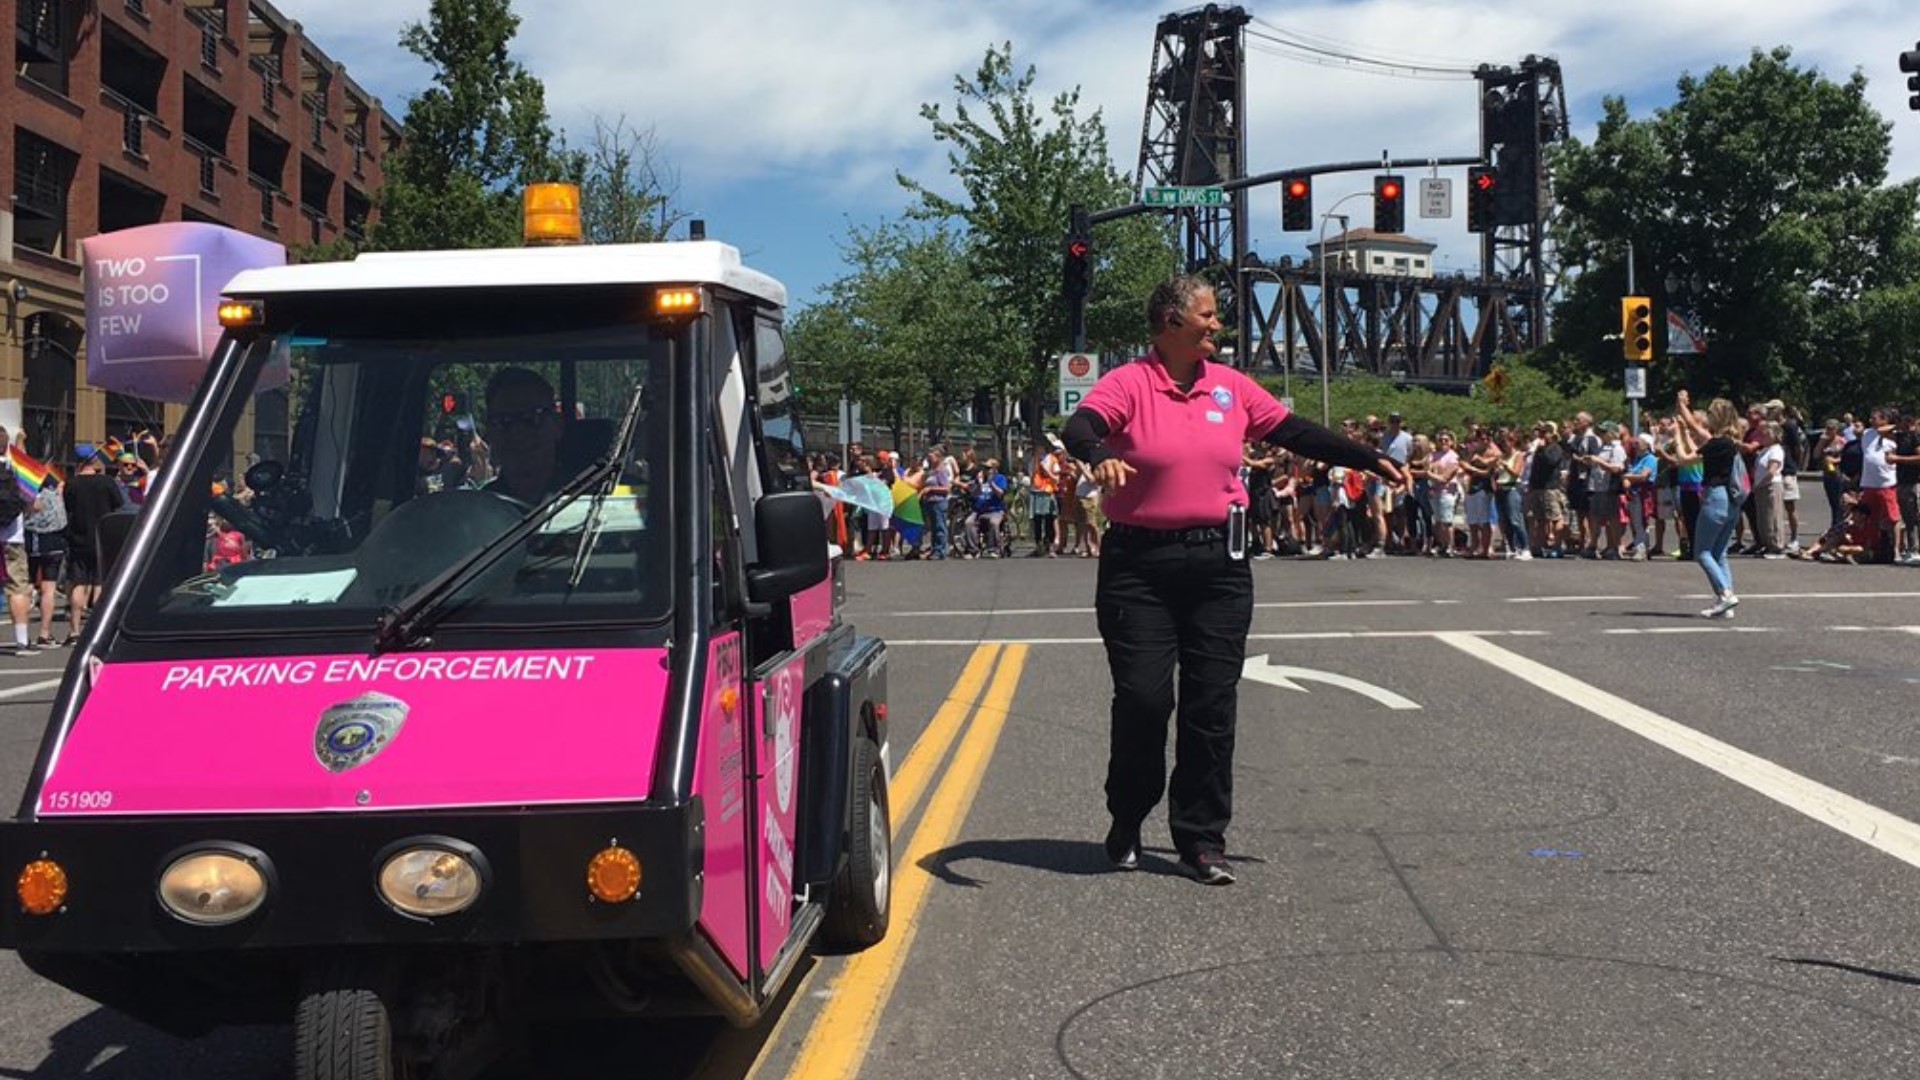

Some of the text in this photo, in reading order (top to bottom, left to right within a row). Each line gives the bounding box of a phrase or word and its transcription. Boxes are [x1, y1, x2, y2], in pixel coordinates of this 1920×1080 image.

[1163, 189, 1219, 203] NW DAVIS ST
[95, 257, 146, 278] TWO
[99, 283, 170, 307] IS TOO
[99, 313, 142, 337] FEW
[161, 655, 595, 692] PARKING ENFORCEMENT
[49, 790, 112, 809] 151909
